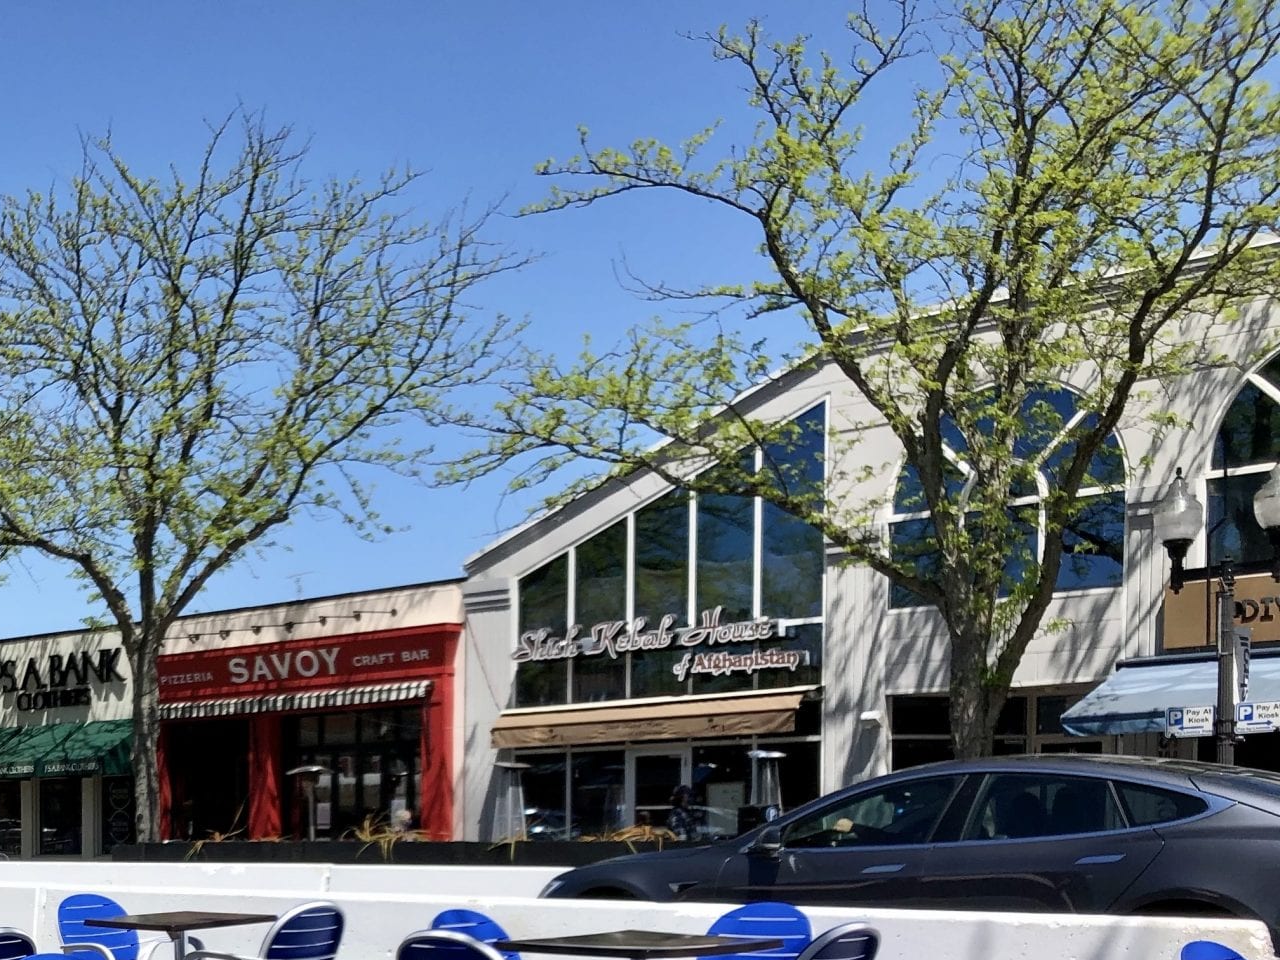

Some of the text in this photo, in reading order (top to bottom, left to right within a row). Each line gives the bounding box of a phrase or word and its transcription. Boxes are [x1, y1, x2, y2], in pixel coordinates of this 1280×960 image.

[1240, 597, 1280, 624] DI
[511, 606, 772, 663] Shish Kebab House
[49, 647, 128, 688] BANK
[160, 647, 430, 686] PIZZERIA SAVOY CRAFT BAR
[673, 649, 799, 681] of Afghanistan
